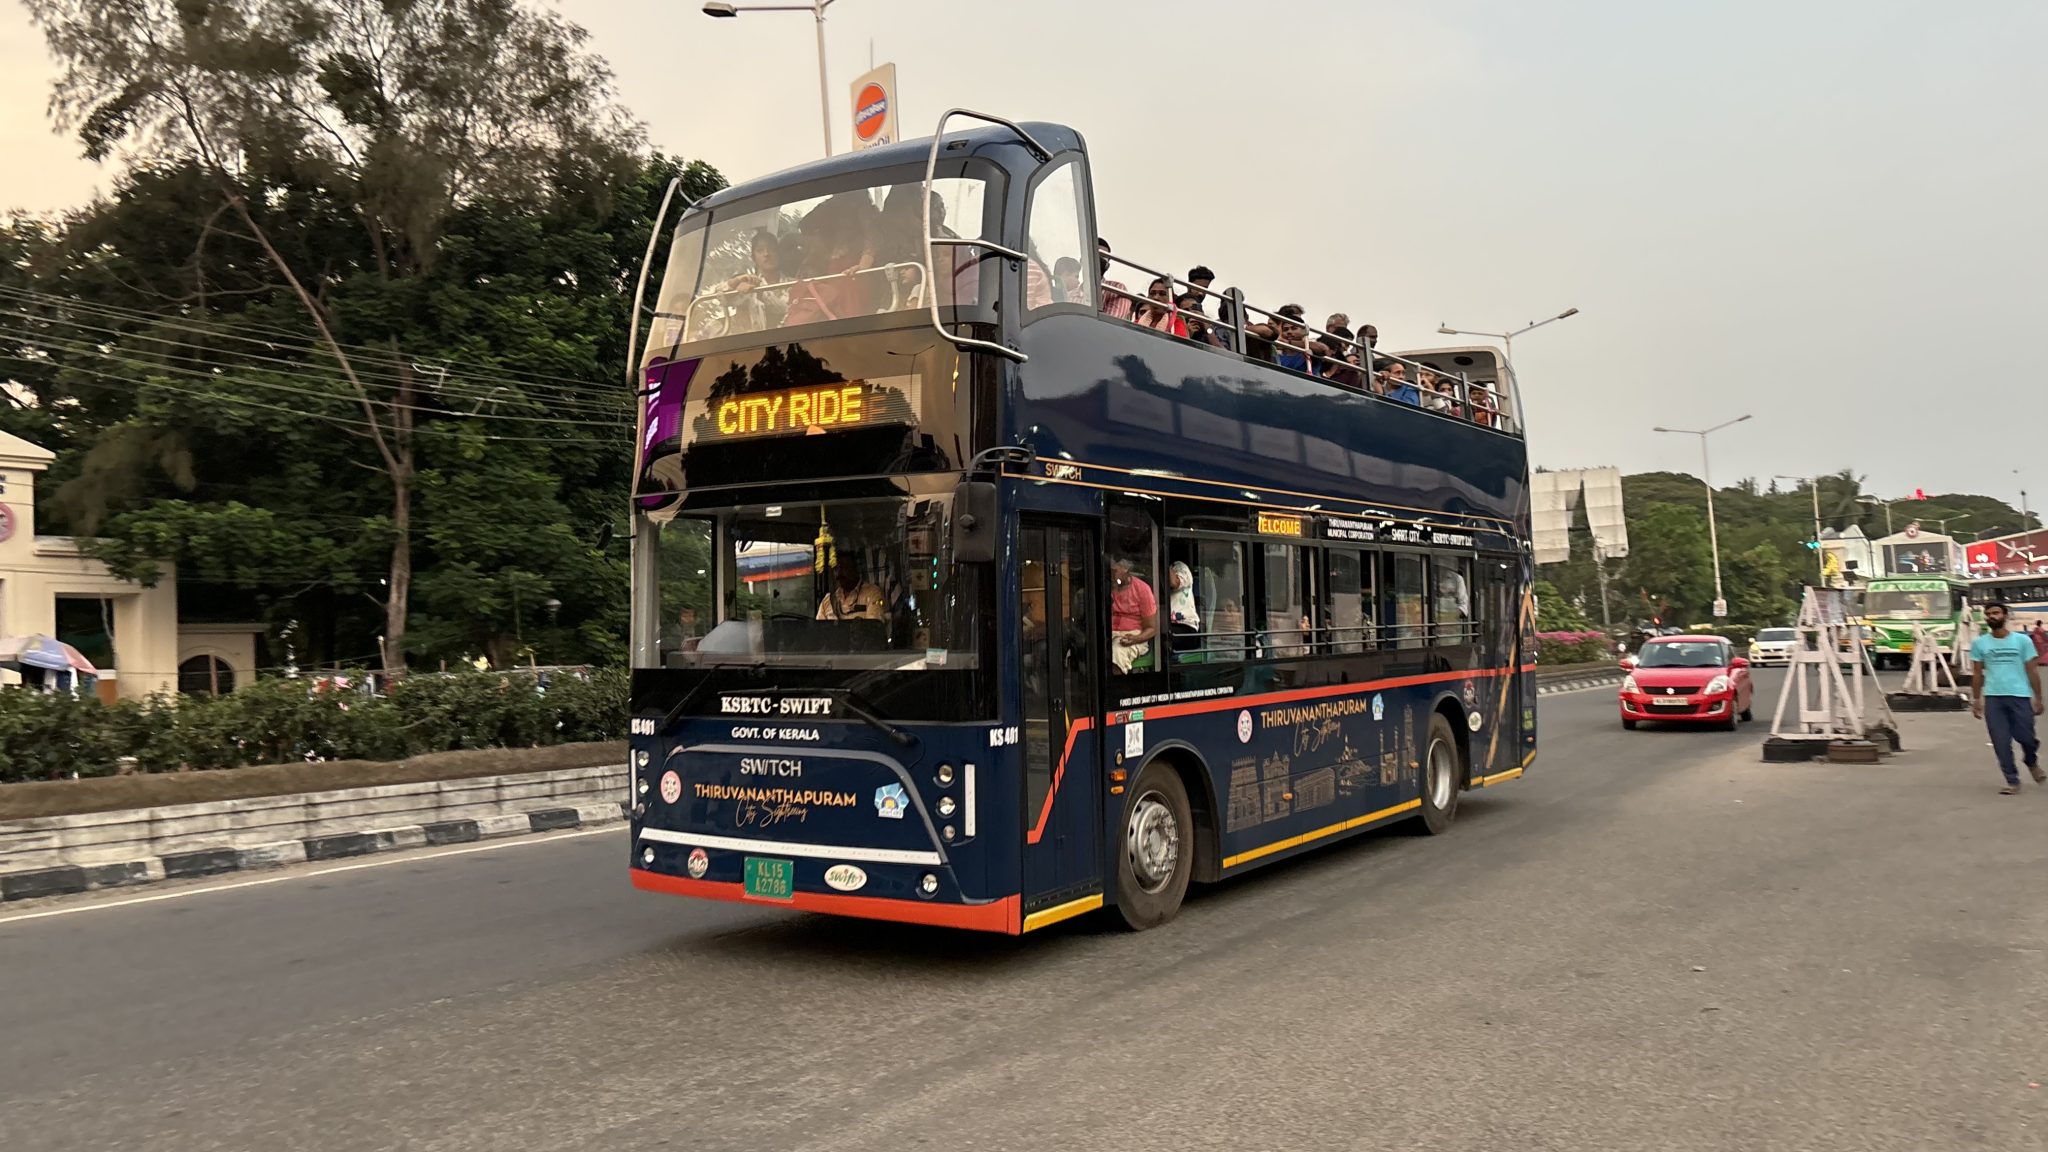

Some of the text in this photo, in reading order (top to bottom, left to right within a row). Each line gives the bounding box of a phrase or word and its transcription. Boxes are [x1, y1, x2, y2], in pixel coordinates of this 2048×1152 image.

[718, 386, 862, 434] CITY RIDE
[1260, 697, 1367, 729] THIRUVANANTHAPURAM
[731, 726, 820, 741] GOVT. OF KERALA
[990, 726, 1019, 747] KS 401
[740, 758, 802, 777] SWITCH
[694, 783, 857, 808] THIRUVANANTHAPURAM
